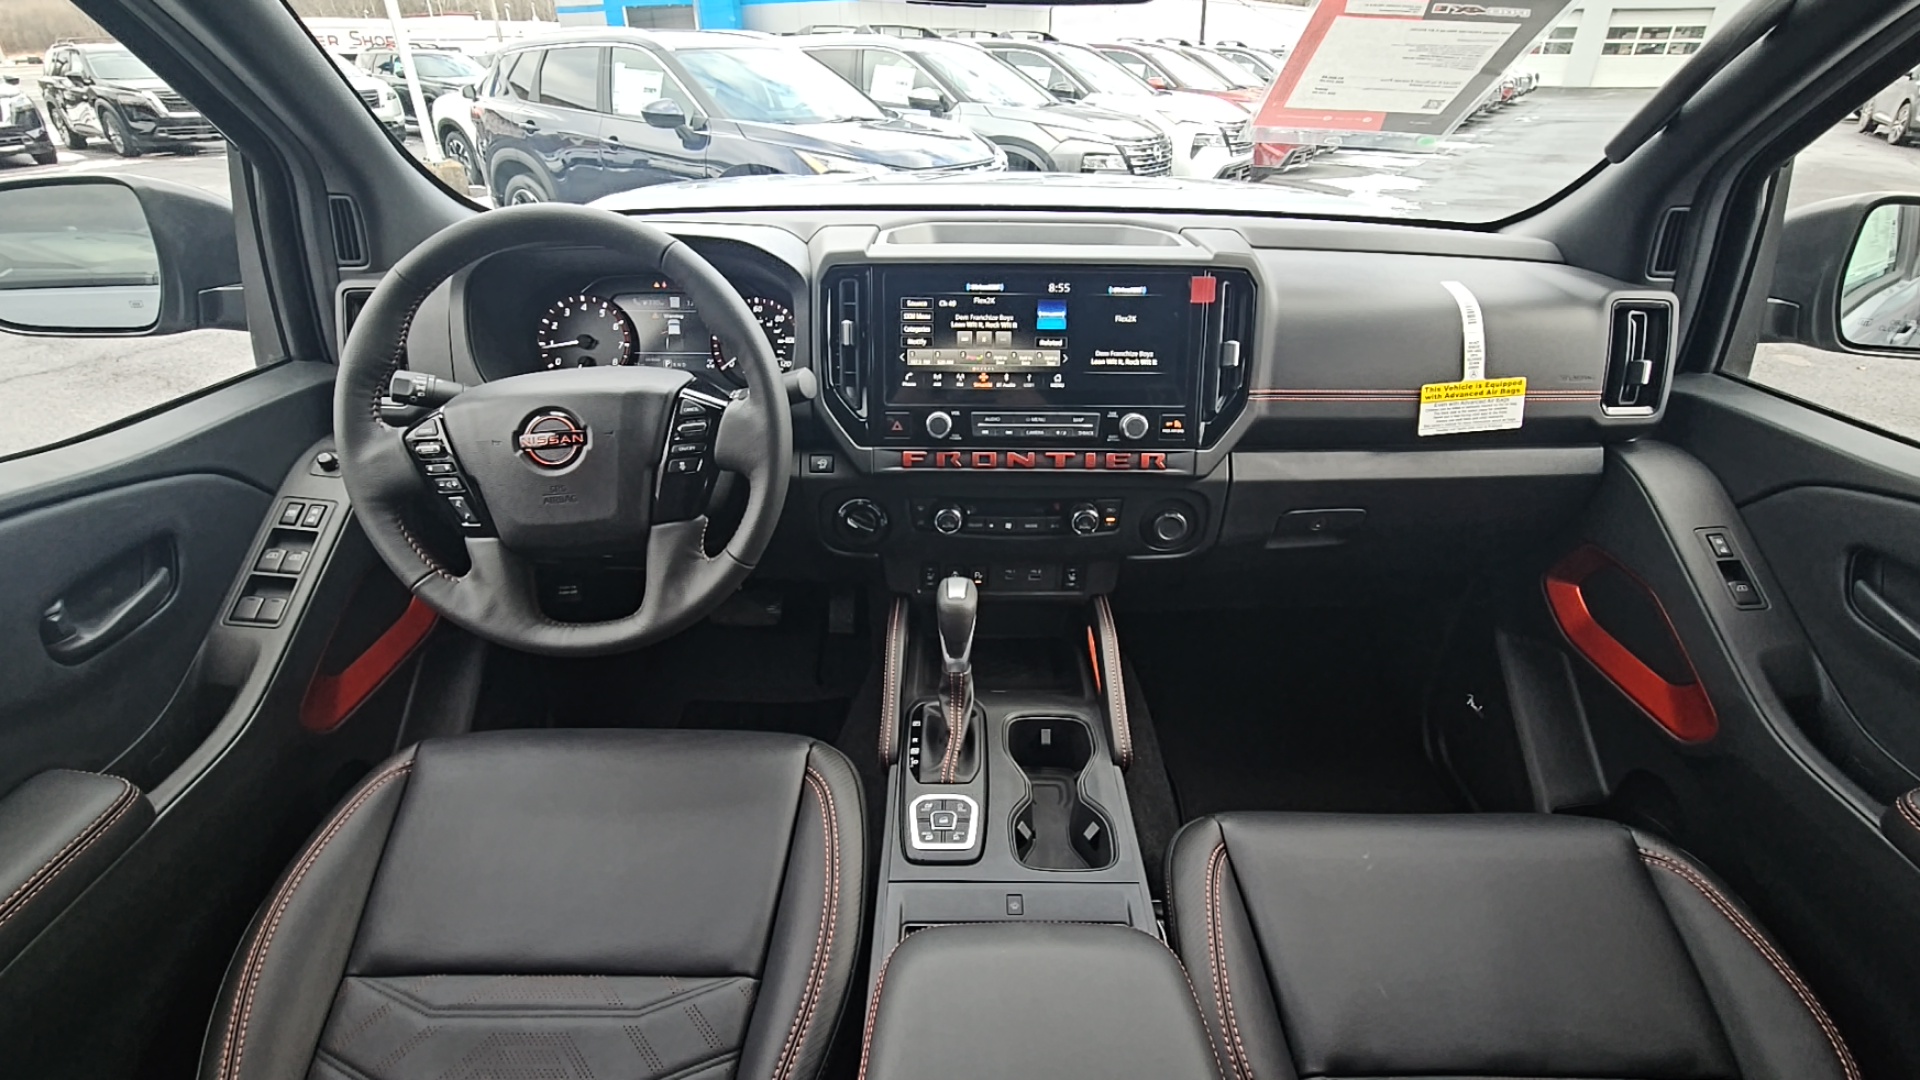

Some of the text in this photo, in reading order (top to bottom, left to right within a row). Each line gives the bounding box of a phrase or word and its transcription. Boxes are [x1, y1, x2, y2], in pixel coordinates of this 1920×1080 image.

[1047, 282, 1071, 294] 8:55
[580, 303, 587, 311] 4
[564, 308, 571, 317] 3
[599, 309, 606, 317] 5
[551, 322, 558, 330] 2
[618, 342, 624, 350] 7
[555, 358, 562, 366] 0
[1444, 384, 1473, 392] Vehicle
[1485, 380, 1523, 388] Equipped
[1444, 391, 1484, 399] Advanced
[520, 434, 584, 448] NISSAN
[902, 450, 1167, 470] FRONTIER
[543, 495, 578, 505] AIRBAG
